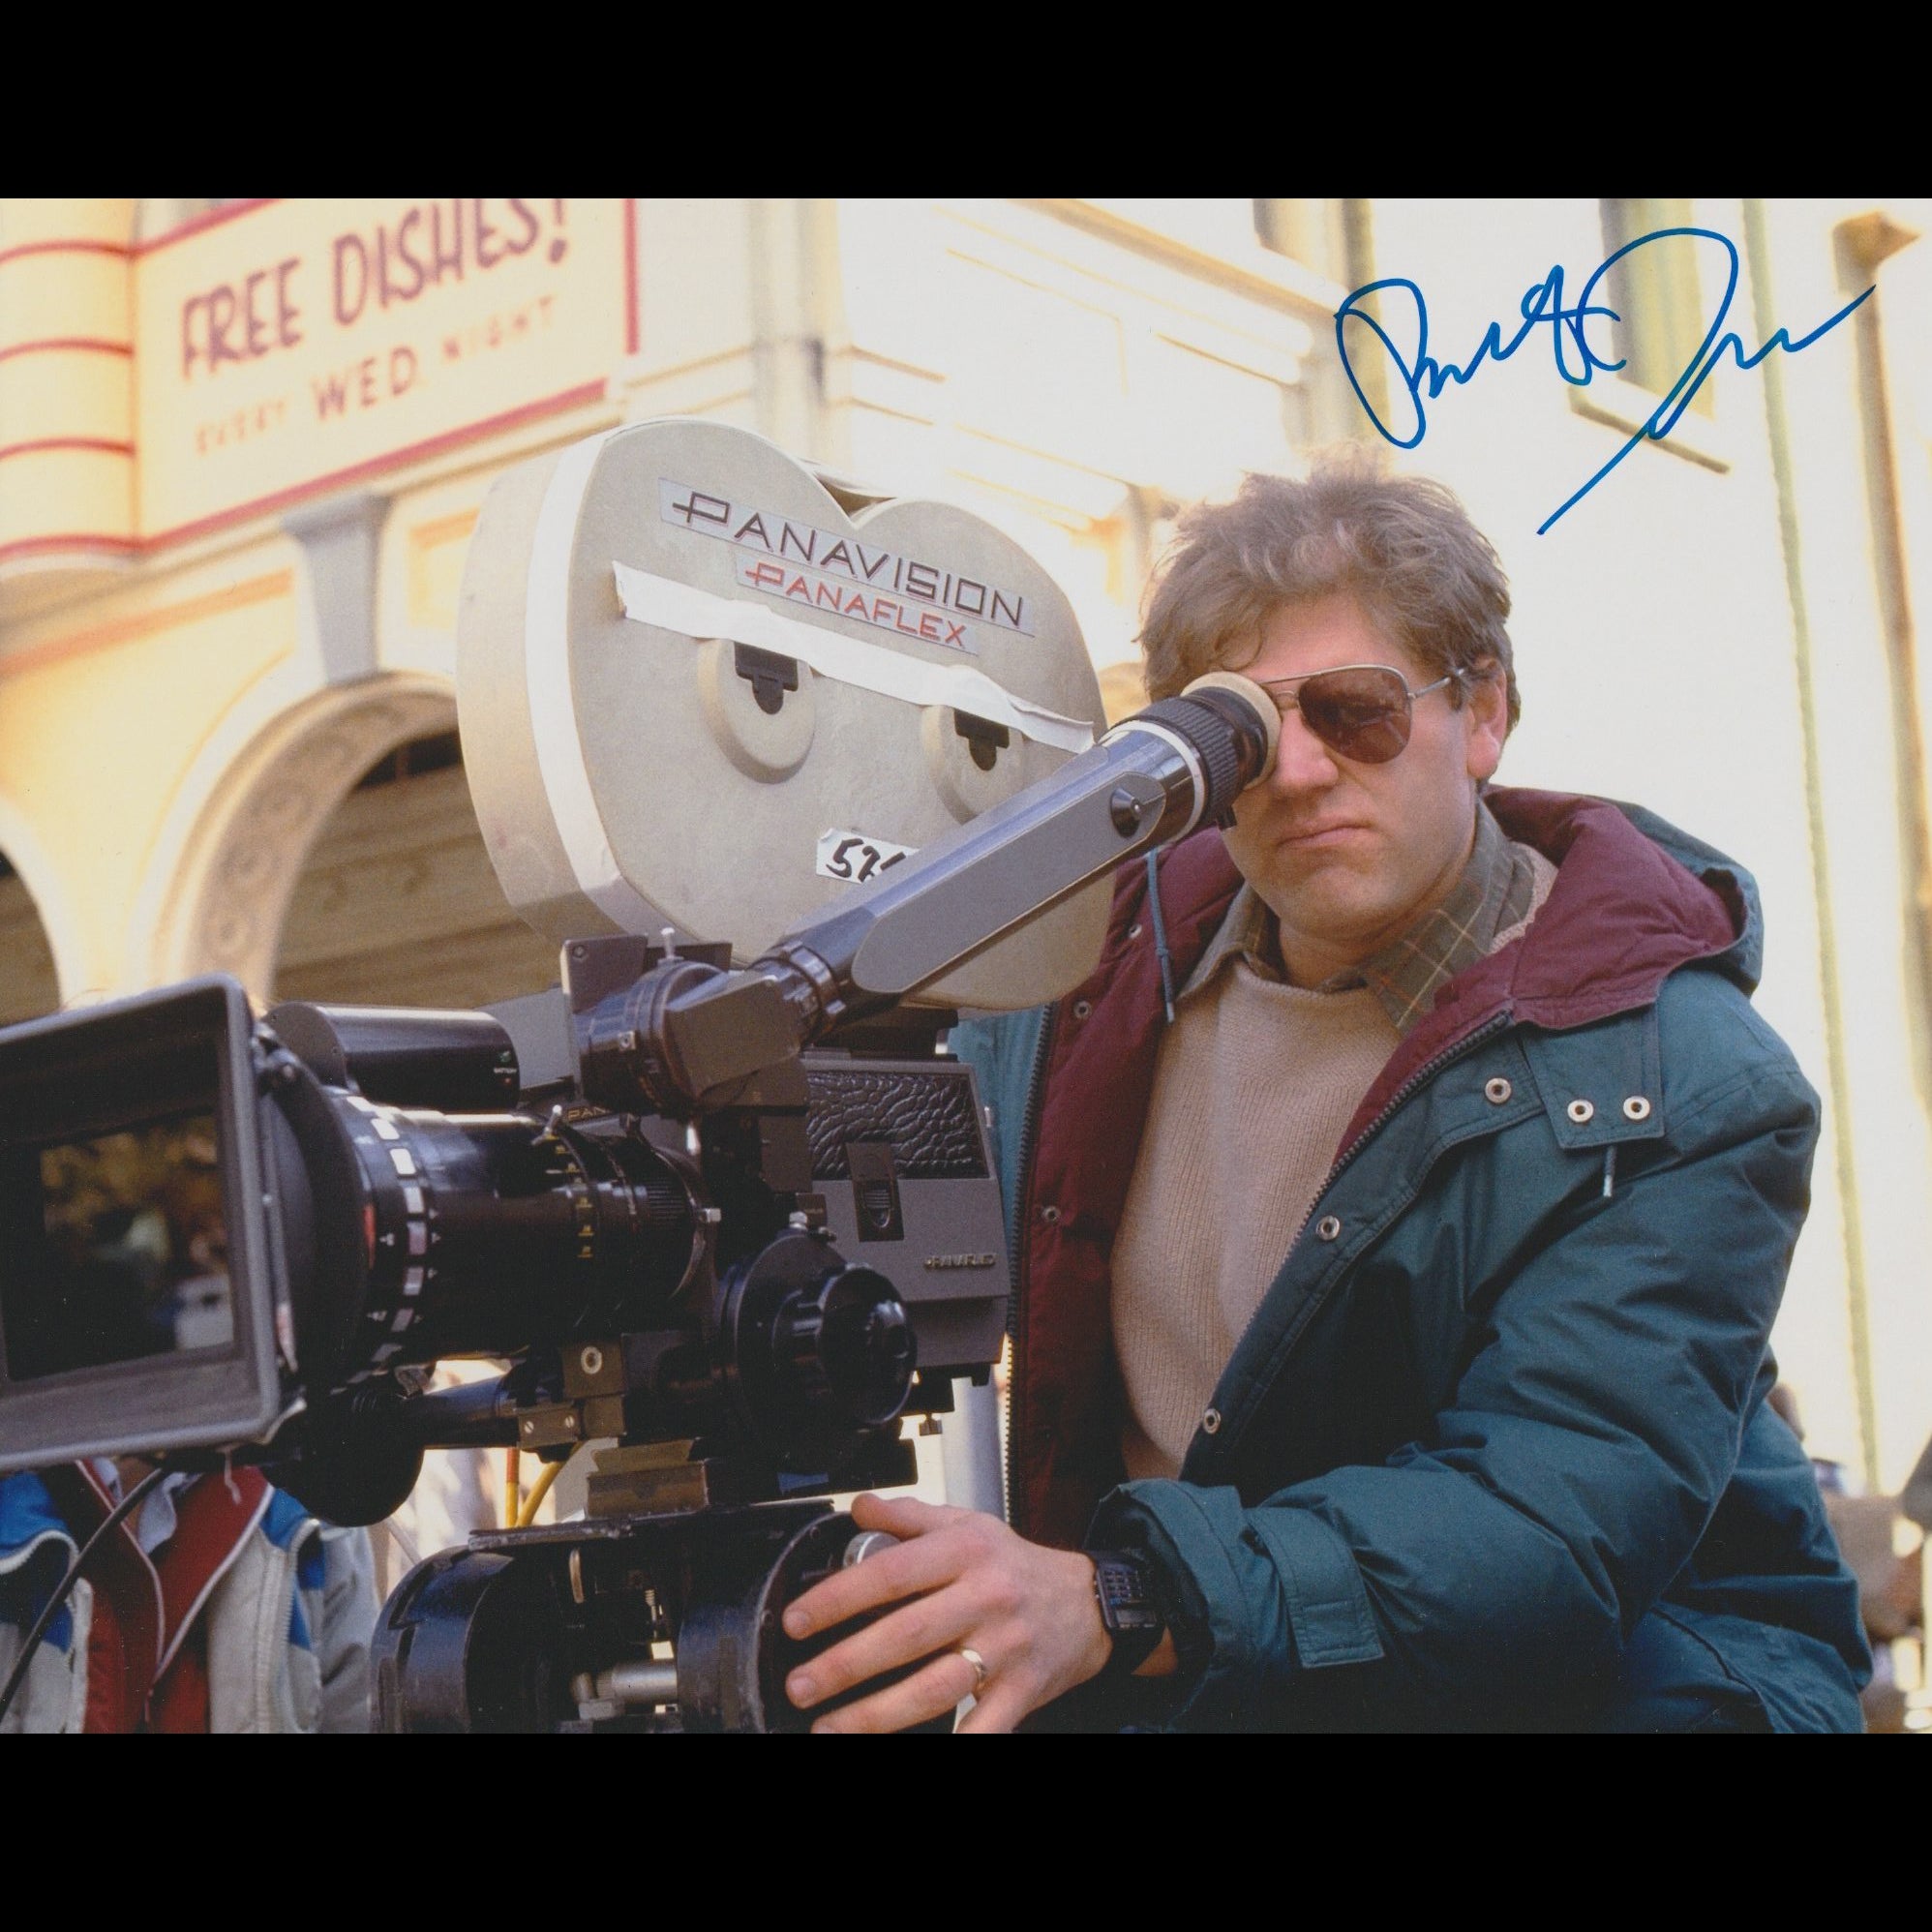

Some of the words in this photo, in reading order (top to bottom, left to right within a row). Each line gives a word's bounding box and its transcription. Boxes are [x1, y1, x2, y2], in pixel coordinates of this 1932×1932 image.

[181, 258, 302, 379] FREE
[333, 198, 566, 326] DISHES!
[672, 492, 1023, 627] PANAVISION
[745, 561, 966, 648] PANAFLEX
